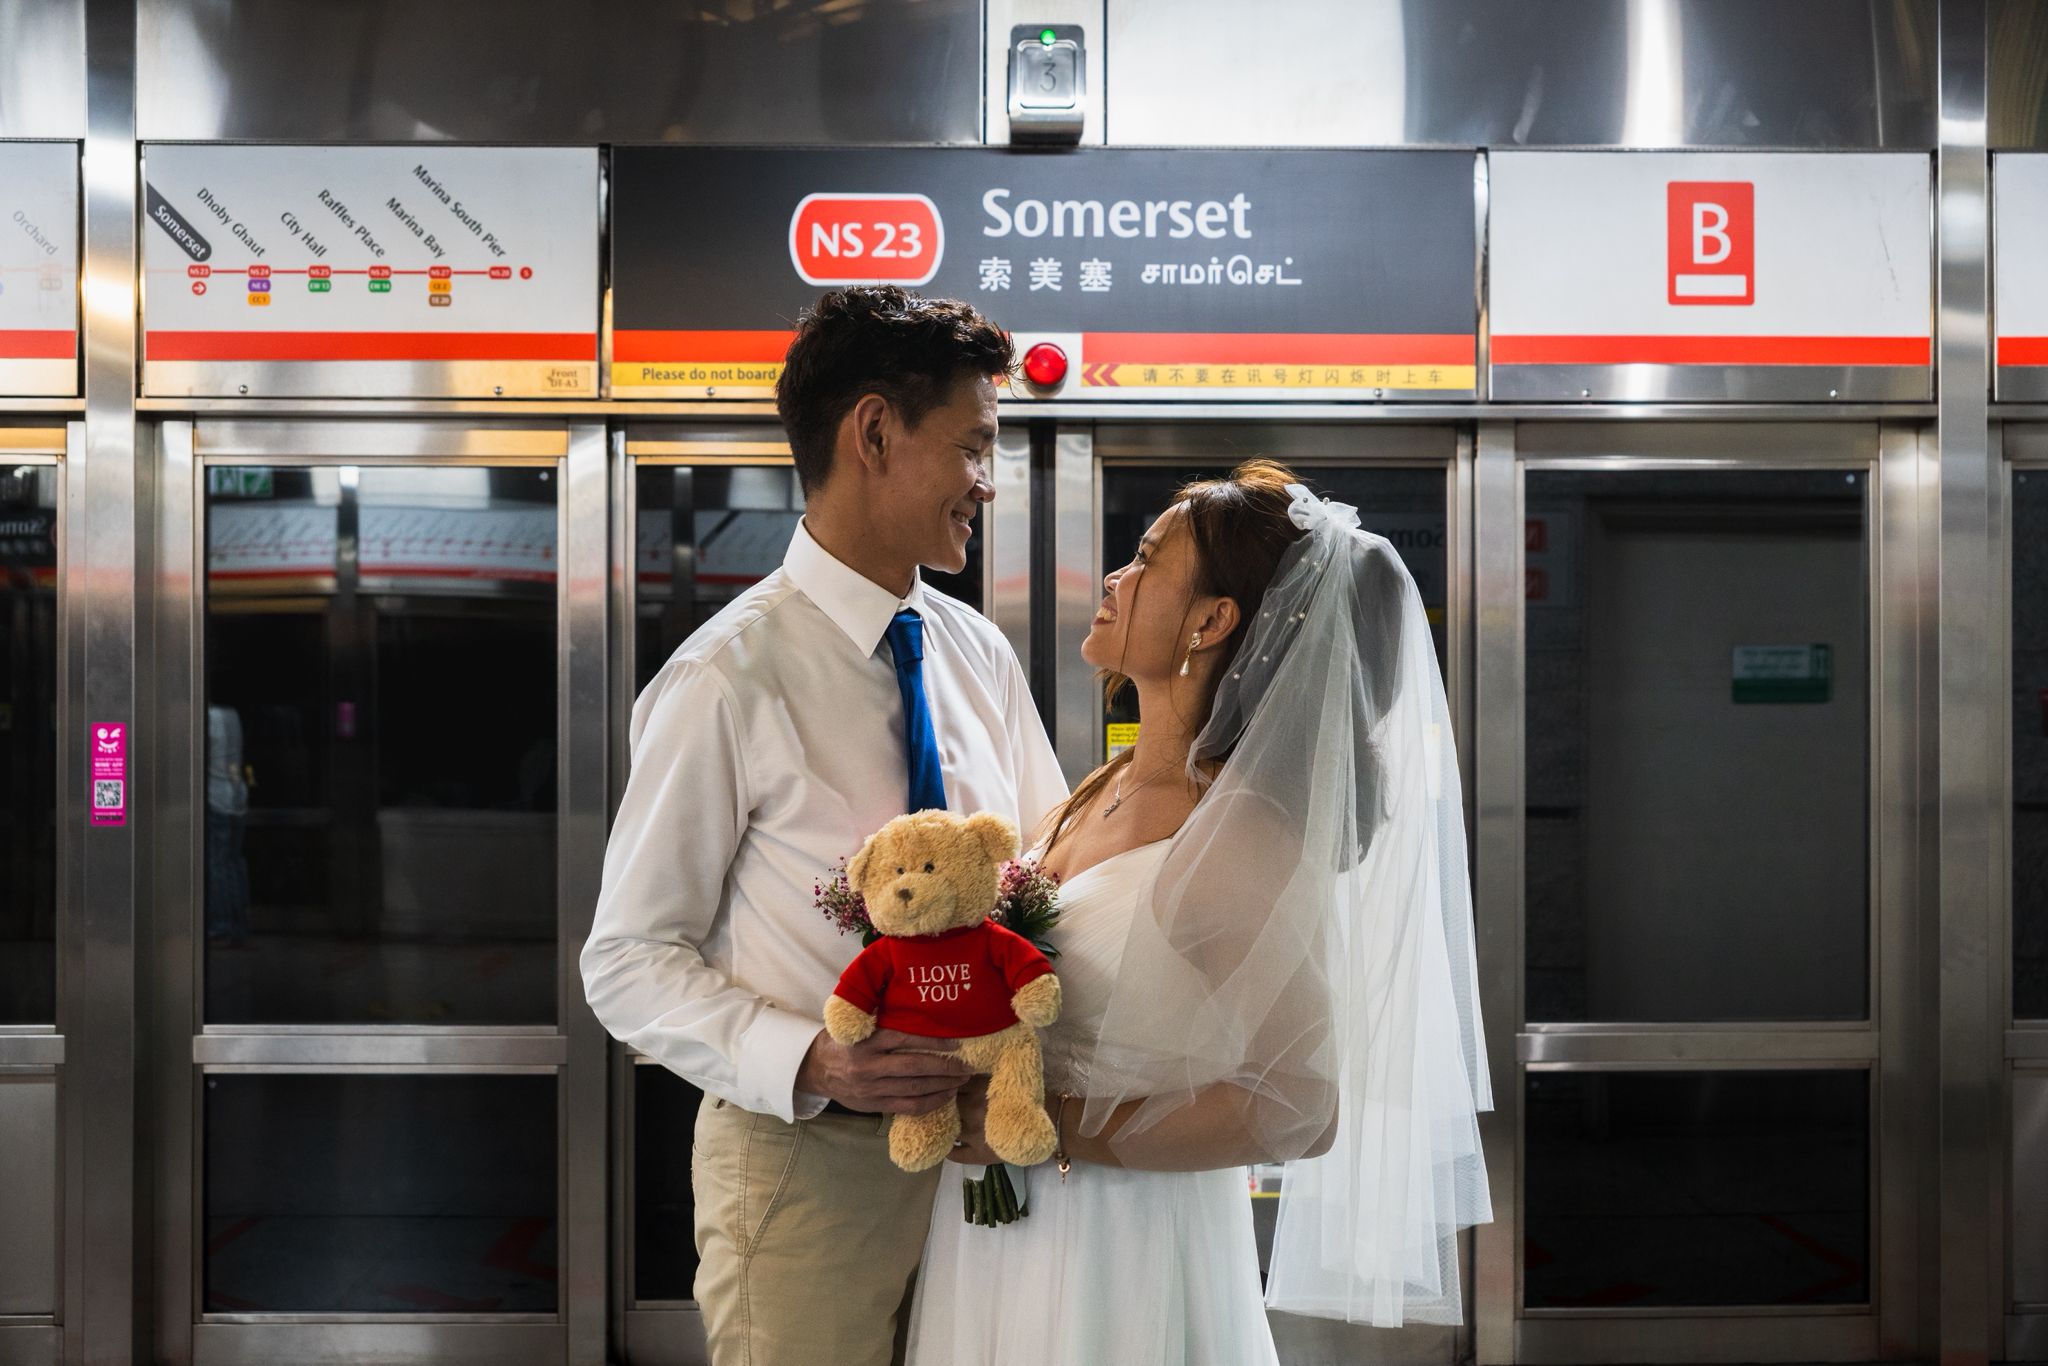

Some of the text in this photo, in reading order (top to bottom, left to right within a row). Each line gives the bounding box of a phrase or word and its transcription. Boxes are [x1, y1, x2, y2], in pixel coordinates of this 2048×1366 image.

[1040, 62, 1057, 92] 3
[13, 210, 58, 255] Orchard
[155, 205, 206, 258] Somerset
[197, 187, 265, 258] Dhoby Ghaut
[318, 188, 386, 258] Raffles Place
[386, 197, 446, 259] Marina Bay
[412, 164, 506, 258] Marina South Pier
[982, 188, 1252, 239] Somerset
[1693, 202, 1732, 265] B
[281, 211, 328, 258] City Hall
[812, 222, 922, 258] NS 23
[978, 256, 1113, 292] 索美塞
[1141, 254, 1302, 285] சாமர்செட்
[642, 367, 776, 380] Please do not board
[1143, 368, 1443, 384] 请不要在讯号灯闪烁时上车
[908, 963, 971, 983] I LOVE
[917, 983, 960, 1002] YOU
